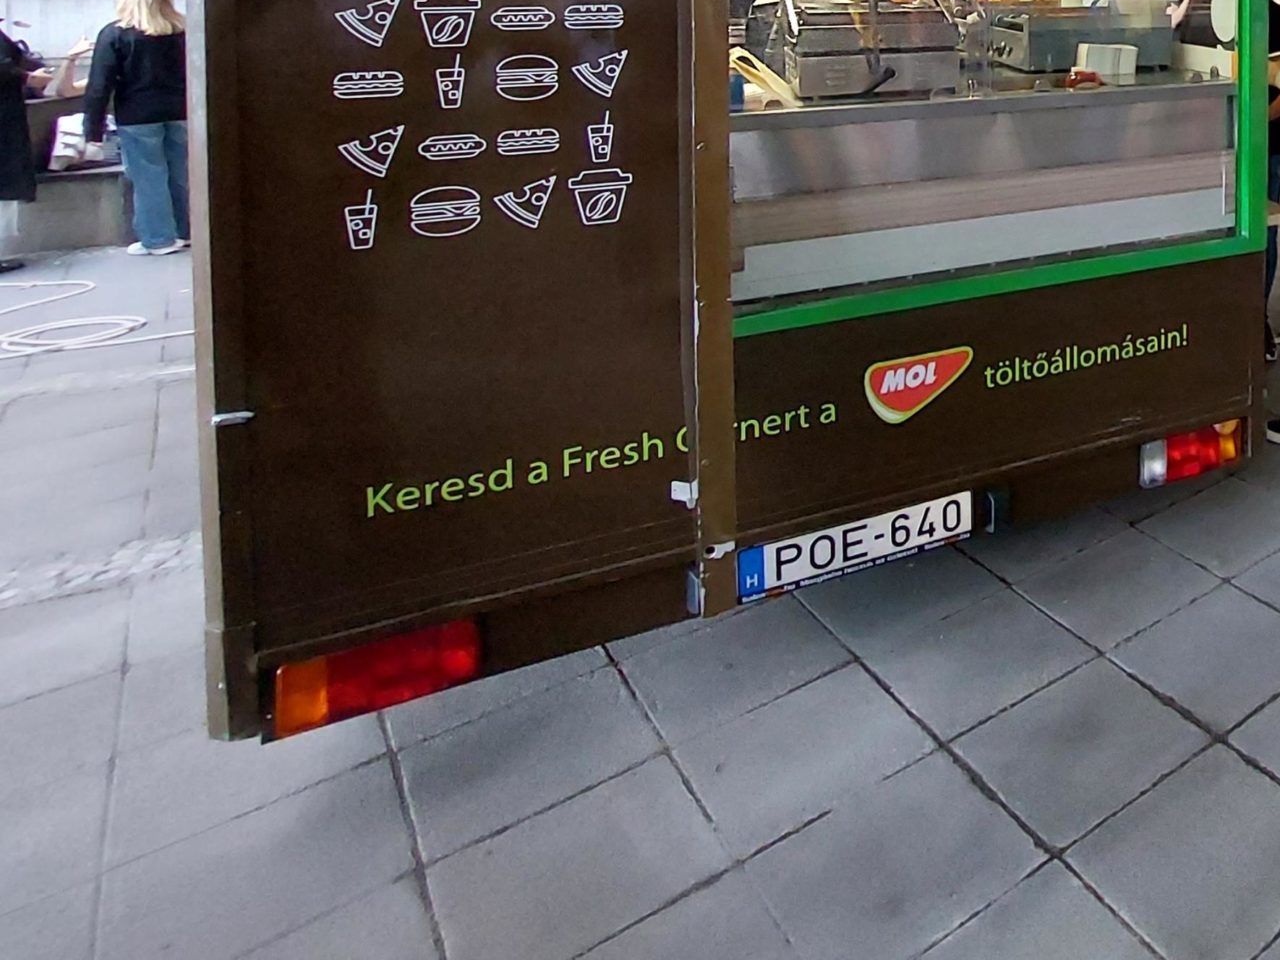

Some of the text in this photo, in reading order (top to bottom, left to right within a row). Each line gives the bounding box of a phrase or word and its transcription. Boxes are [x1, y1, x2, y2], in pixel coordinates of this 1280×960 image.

[880, 361, 938, 395] MOL
[984, 323, 1189, 389] töltőállomásain!
[366, 402, 837, 517] Keresd a Fresh Cnert a
[775, 499, 962, 582] POE-640
[745, 573, 759, 589] H
